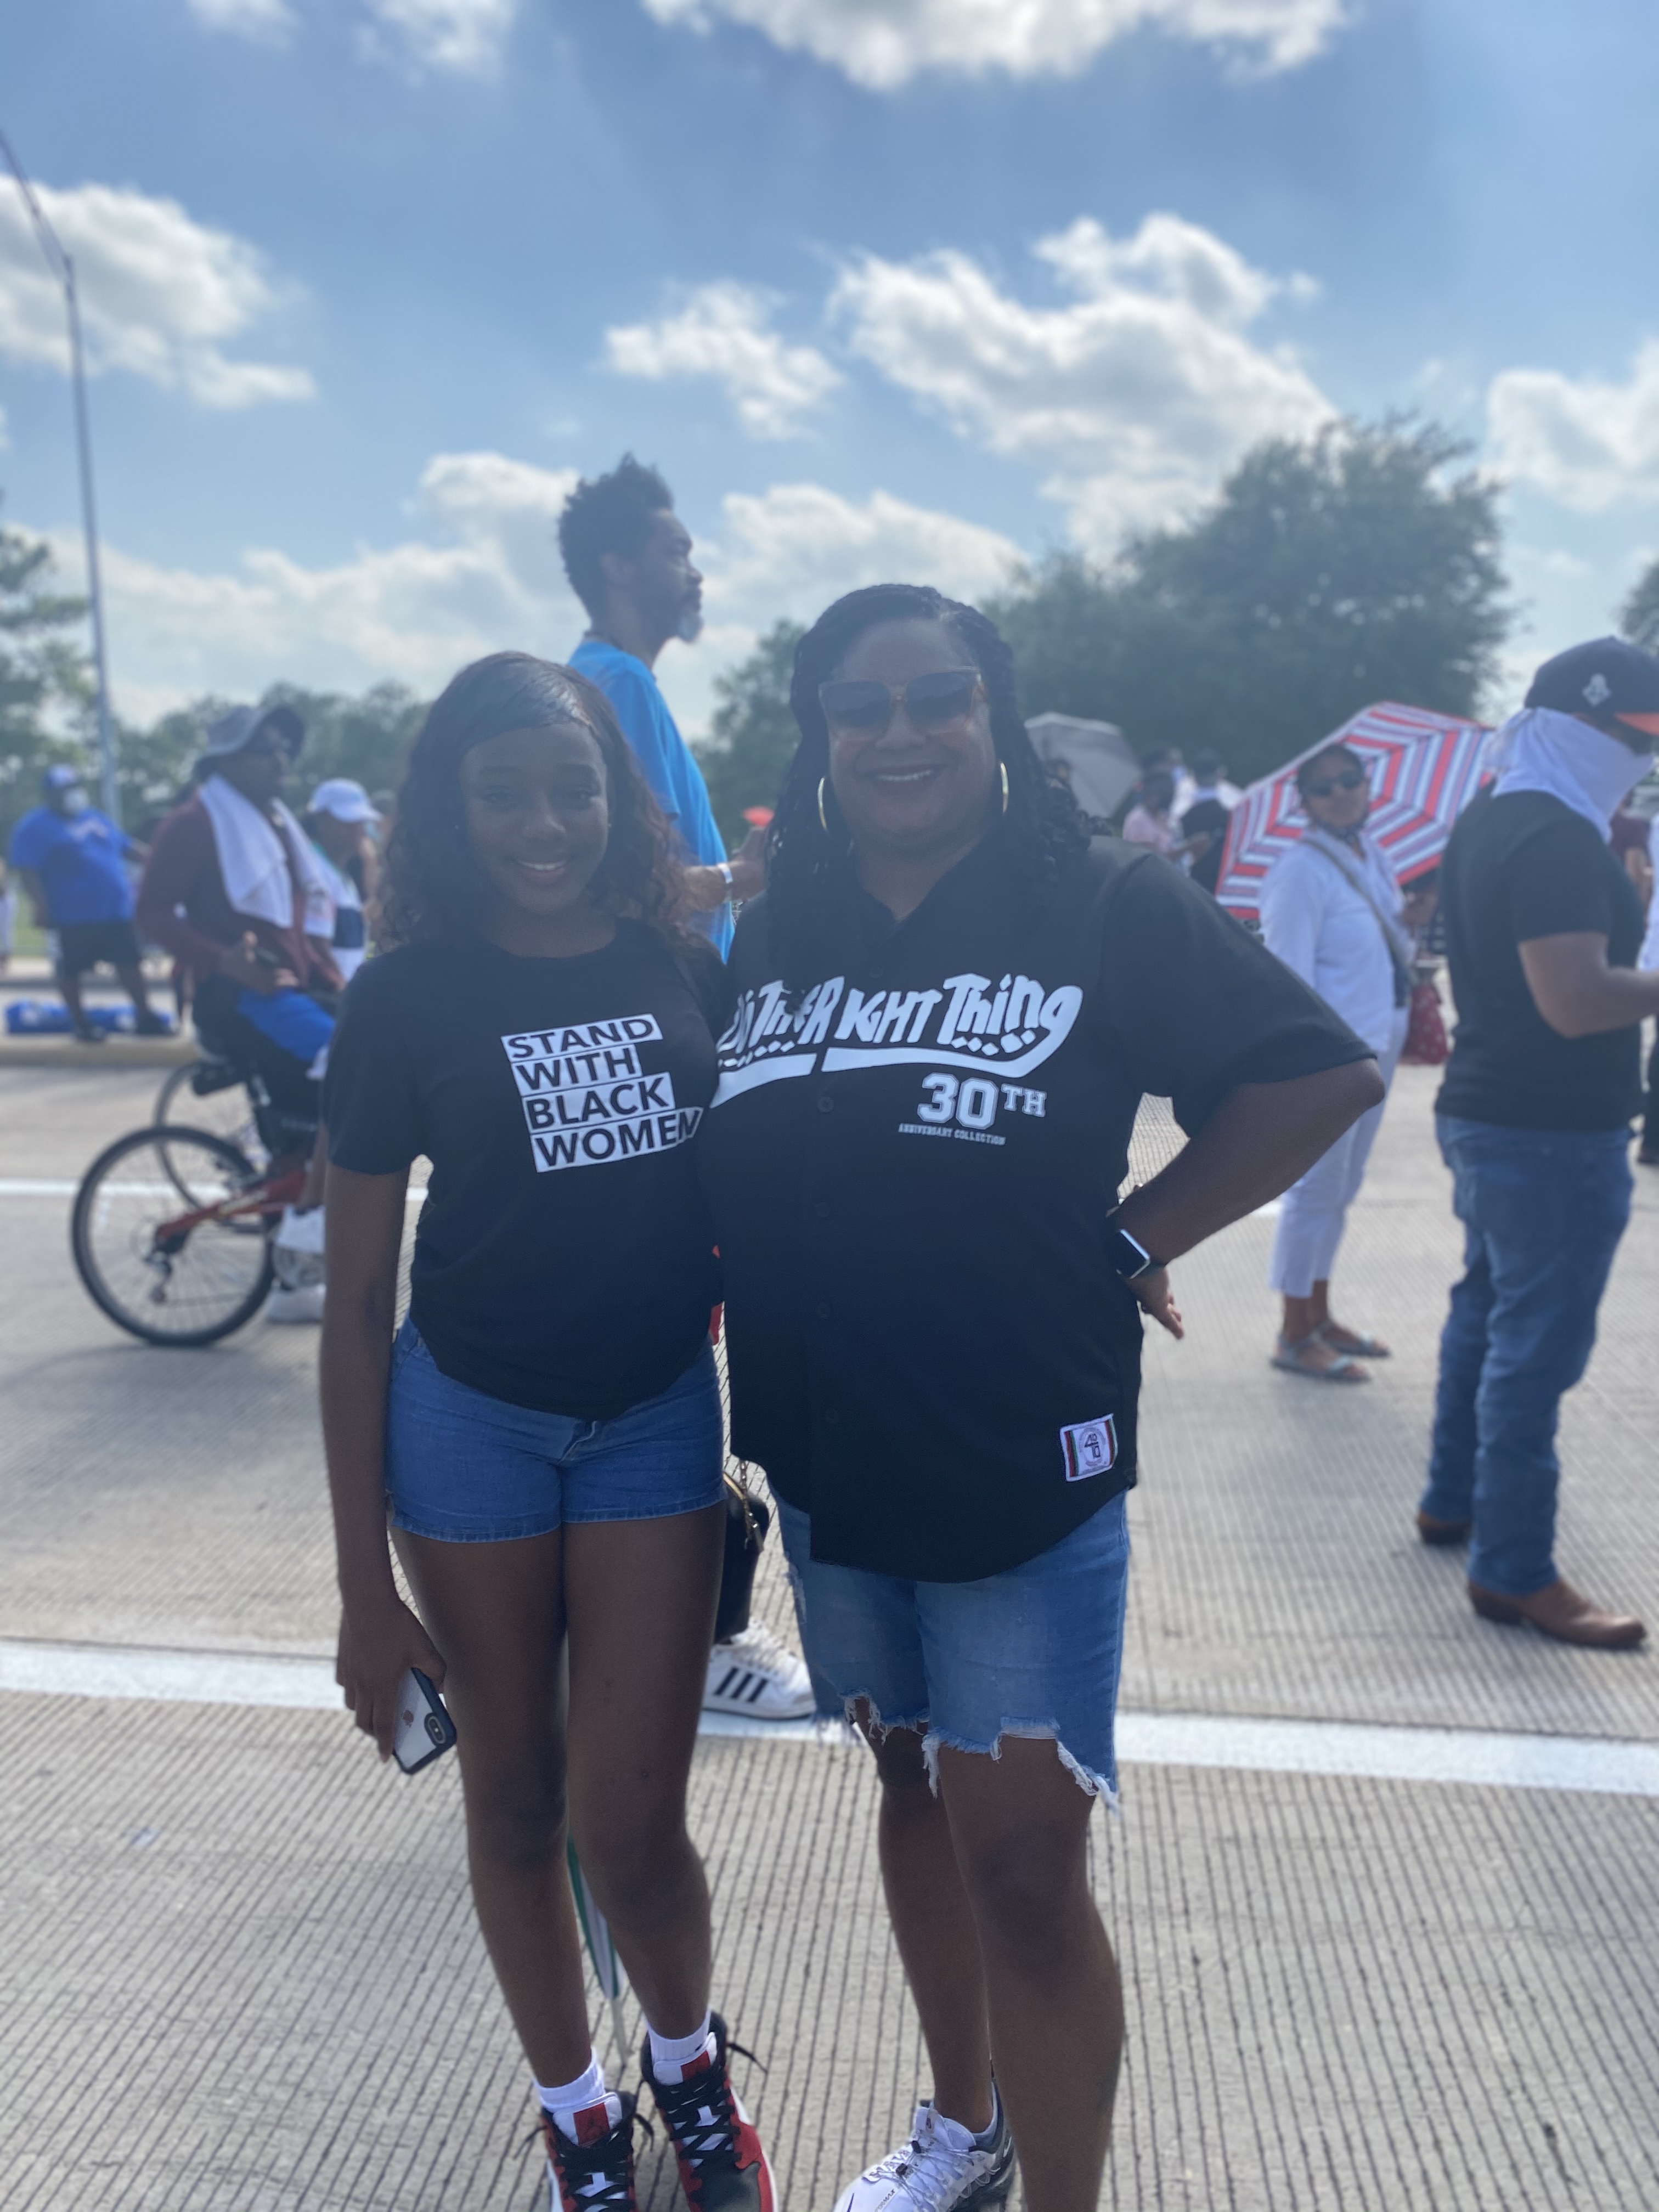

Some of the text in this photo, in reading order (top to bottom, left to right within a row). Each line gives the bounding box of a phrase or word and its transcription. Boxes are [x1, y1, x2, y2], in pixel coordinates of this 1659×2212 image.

[507, 1018, 654, 1059] STAND
[936, 973, 1084, 1078] Thing
[516, 1047, 636, 1091] WITH
[526, 1076, 669, 1130] BLACK
[917, 1072, 1047, 1130] 30TH
[535, 1110, 700, 1167] WOMEN
